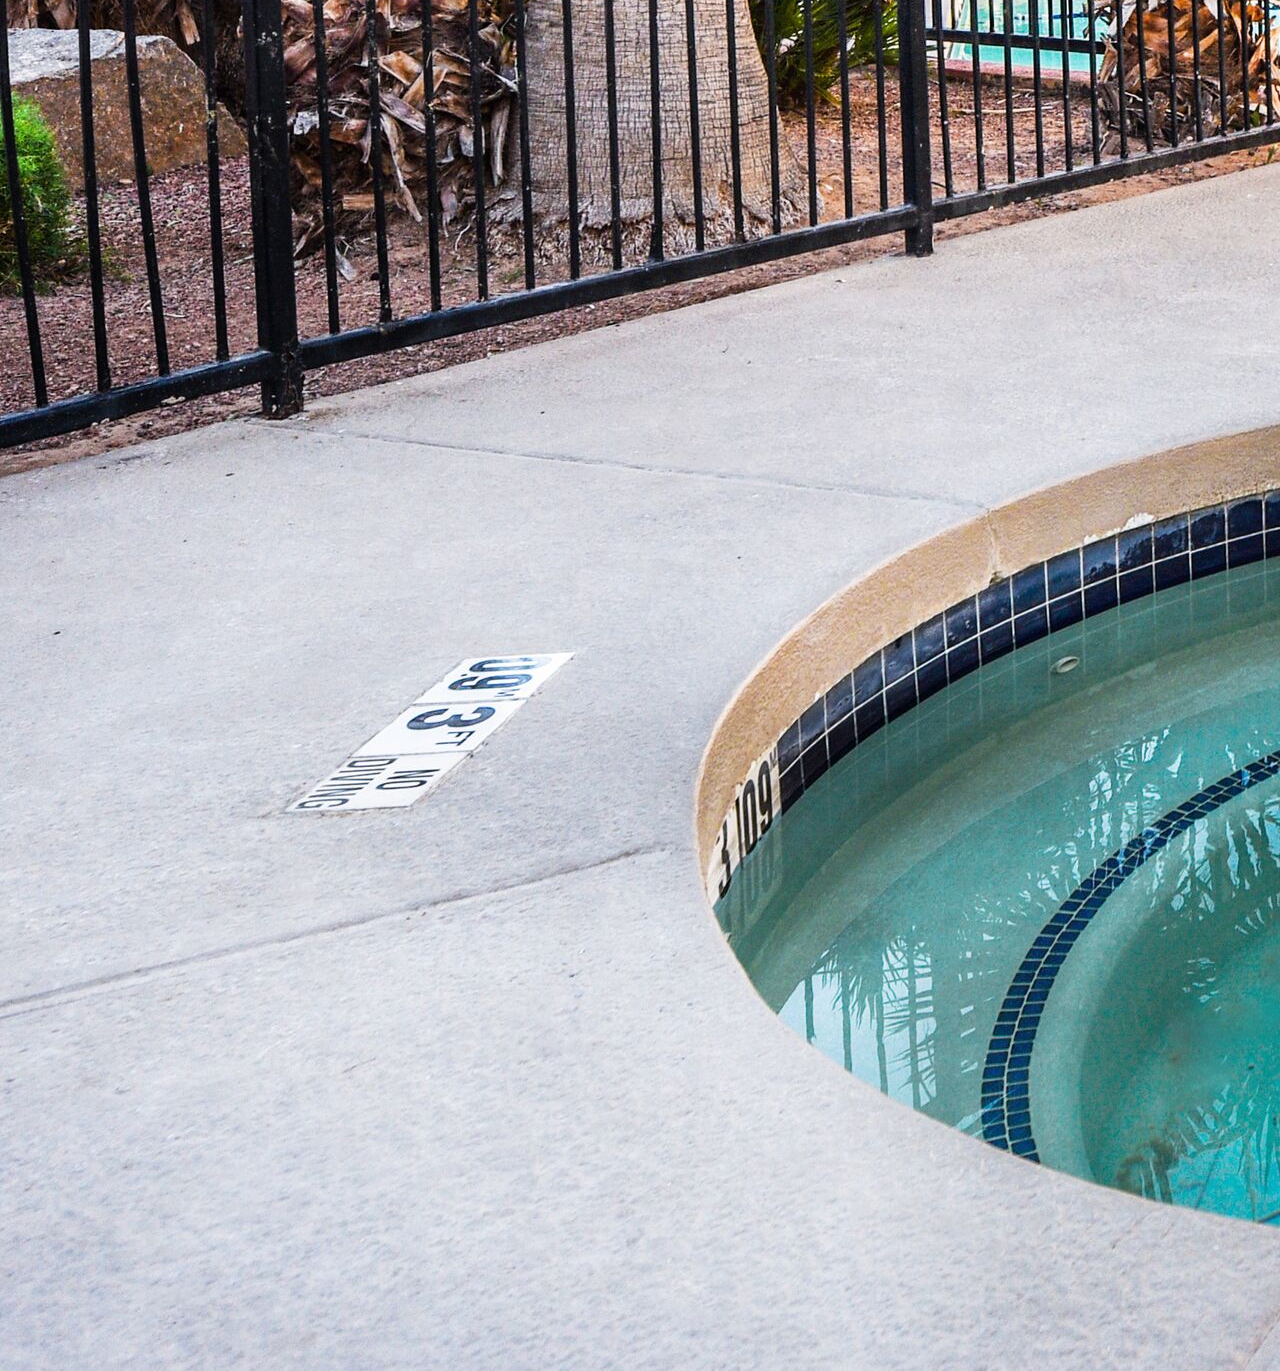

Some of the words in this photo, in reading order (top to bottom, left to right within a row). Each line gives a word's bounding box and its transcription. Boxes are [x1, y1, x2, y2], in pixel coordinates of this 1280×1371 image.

[406, 706, 496, 730] 3
[435, 730, 476, 746] FT
[295, 757, 399, 809] DIVING
[375, 768, 441, 790] NO
